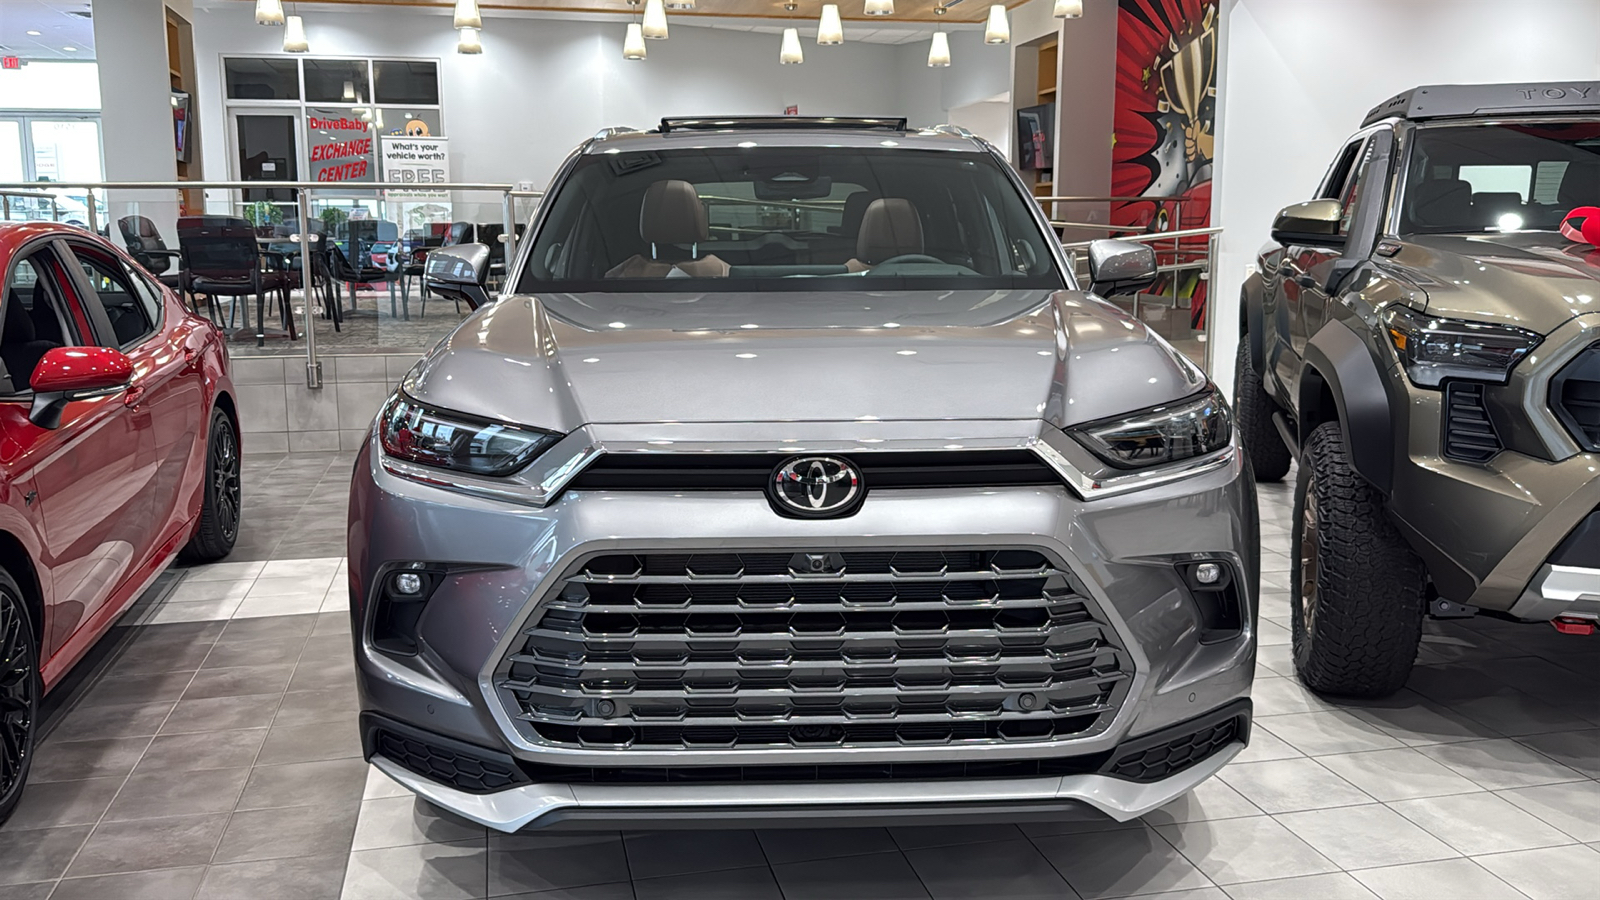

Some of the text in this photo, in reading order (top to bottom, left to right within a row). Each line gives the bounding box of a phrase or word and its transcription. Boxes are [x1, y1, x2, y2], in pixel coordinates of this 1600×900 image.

[1516, 87, 1600, 100] TOY
[310, 117, 369, 133] DriveBaby
[312, 138, 371, 162] EXCHANGE
[392, 143, 439, 152] What's your
[387, 152, 446, 161] vehicle worth?
[318, 160, 368, 182] CENTER
[388, 169, 445, 192] FREE
